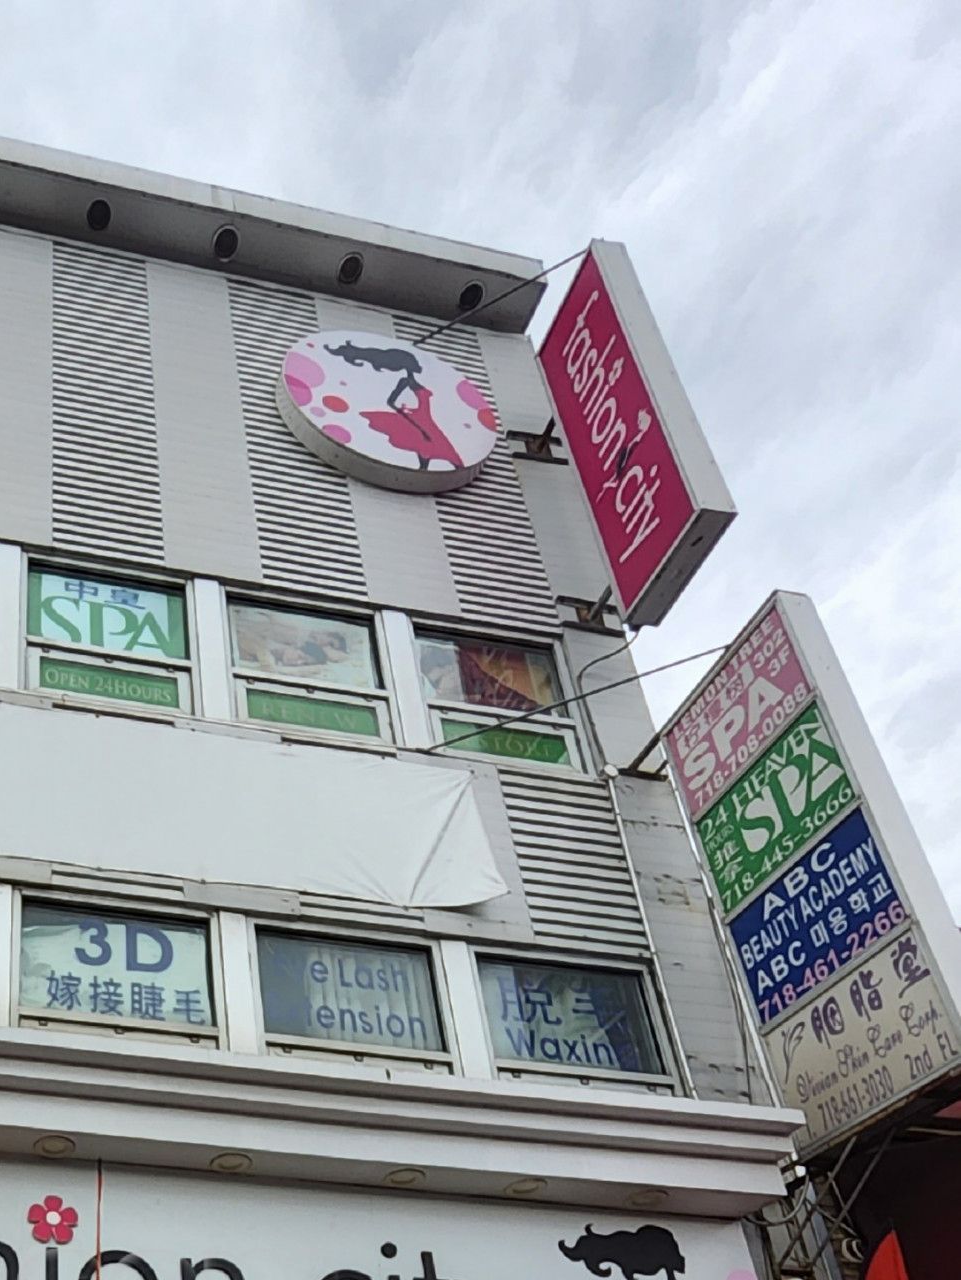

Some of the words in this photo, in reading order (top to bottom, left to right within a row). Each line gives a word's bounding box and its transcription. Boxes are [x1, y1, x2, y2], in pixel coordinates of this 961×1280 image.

[562, 291, 627, 472] fashion
[616, 464, 661, 563] city
[41, 595, 169, 657] SPA
[672, 668, 728, 740] LEMON
[729, 614, 774, 672] TREE
[683, 674, 784, 793] SPA
[729, 709, 824, 813] HEAVEN
[699, 802, 729, 842] 24
[721, 780, 854, 909] 718-445-3666
[740, 732, 845, 856] SPA
[739, 904, 800, 971] BEAUTY
[795, 836, 881, 923] ACADEMY
[761, 842, 836, 921] ABC
[74, 919, 175, 974] 3D
[752, 939, 808, 996] ABC
[757, 899, 908, 1023] 718-461-2266
[505, 1026, 638, 1071] Waxin
